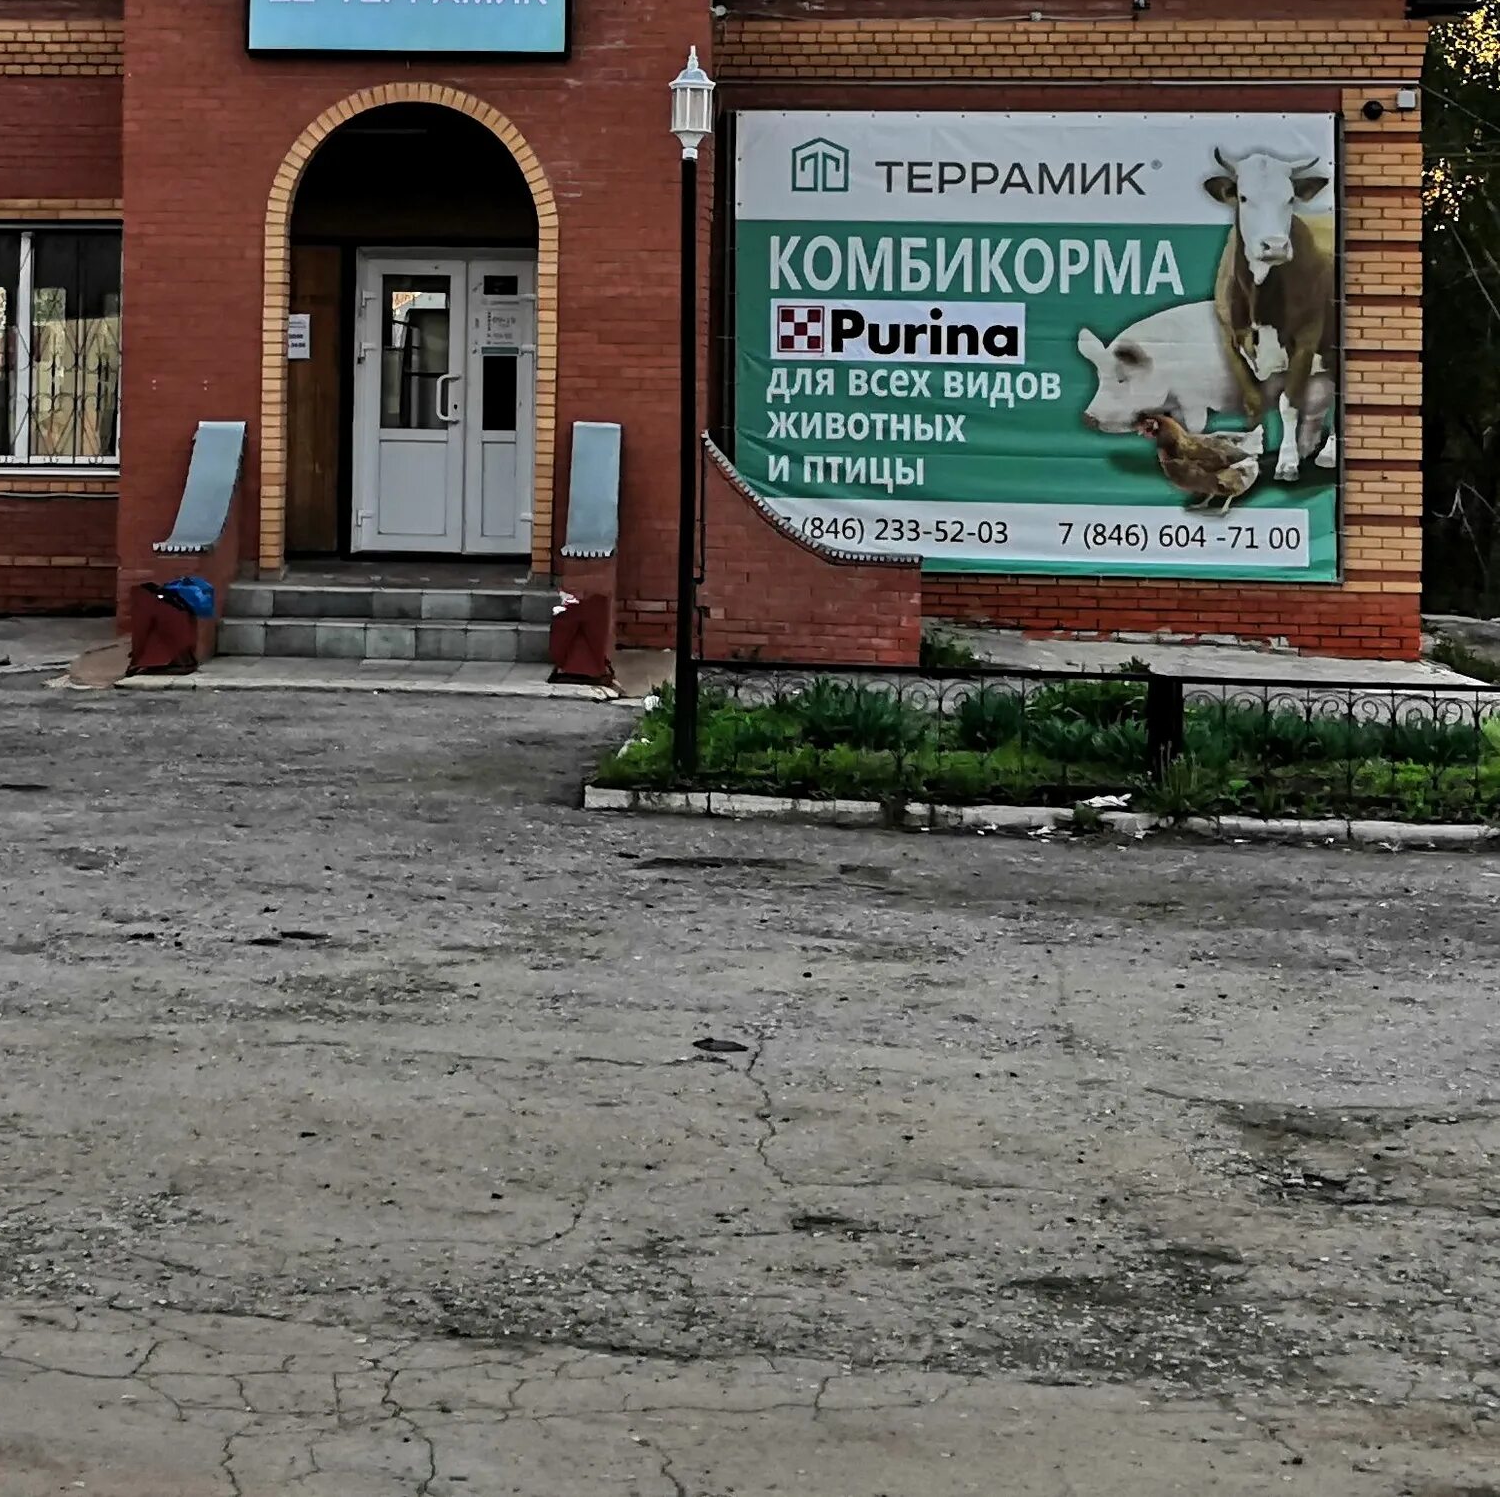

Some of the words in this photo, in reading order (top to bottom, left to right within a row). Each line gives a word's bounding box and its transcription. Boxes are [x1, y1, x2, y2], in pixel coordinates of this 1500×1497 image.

[875, 161, 1147, 196] ТЕРРАМИК
[769, 235, 1185, 295] КОМБИКОРМА
[830, 307, 1019, 357] Purina
[765, 367, 835, 403] для
[848, 368, 932, 398] всех
[943, 370, 1062, 409] видов
[766, 411, 967, 443] животных
[803, 455, 925, 494] птицы
[801, 516, 865, 545] (846)
[874, 517, 1009, 544] 233-52-03
[1058, 522, 1074, 545] 7
[1083, 523, 1149, 551] (846)
[1158, 524, 1207, 548] 604
[1216, 526, 1259, 550] -71
[1268, 527, 1301, 550] 00
